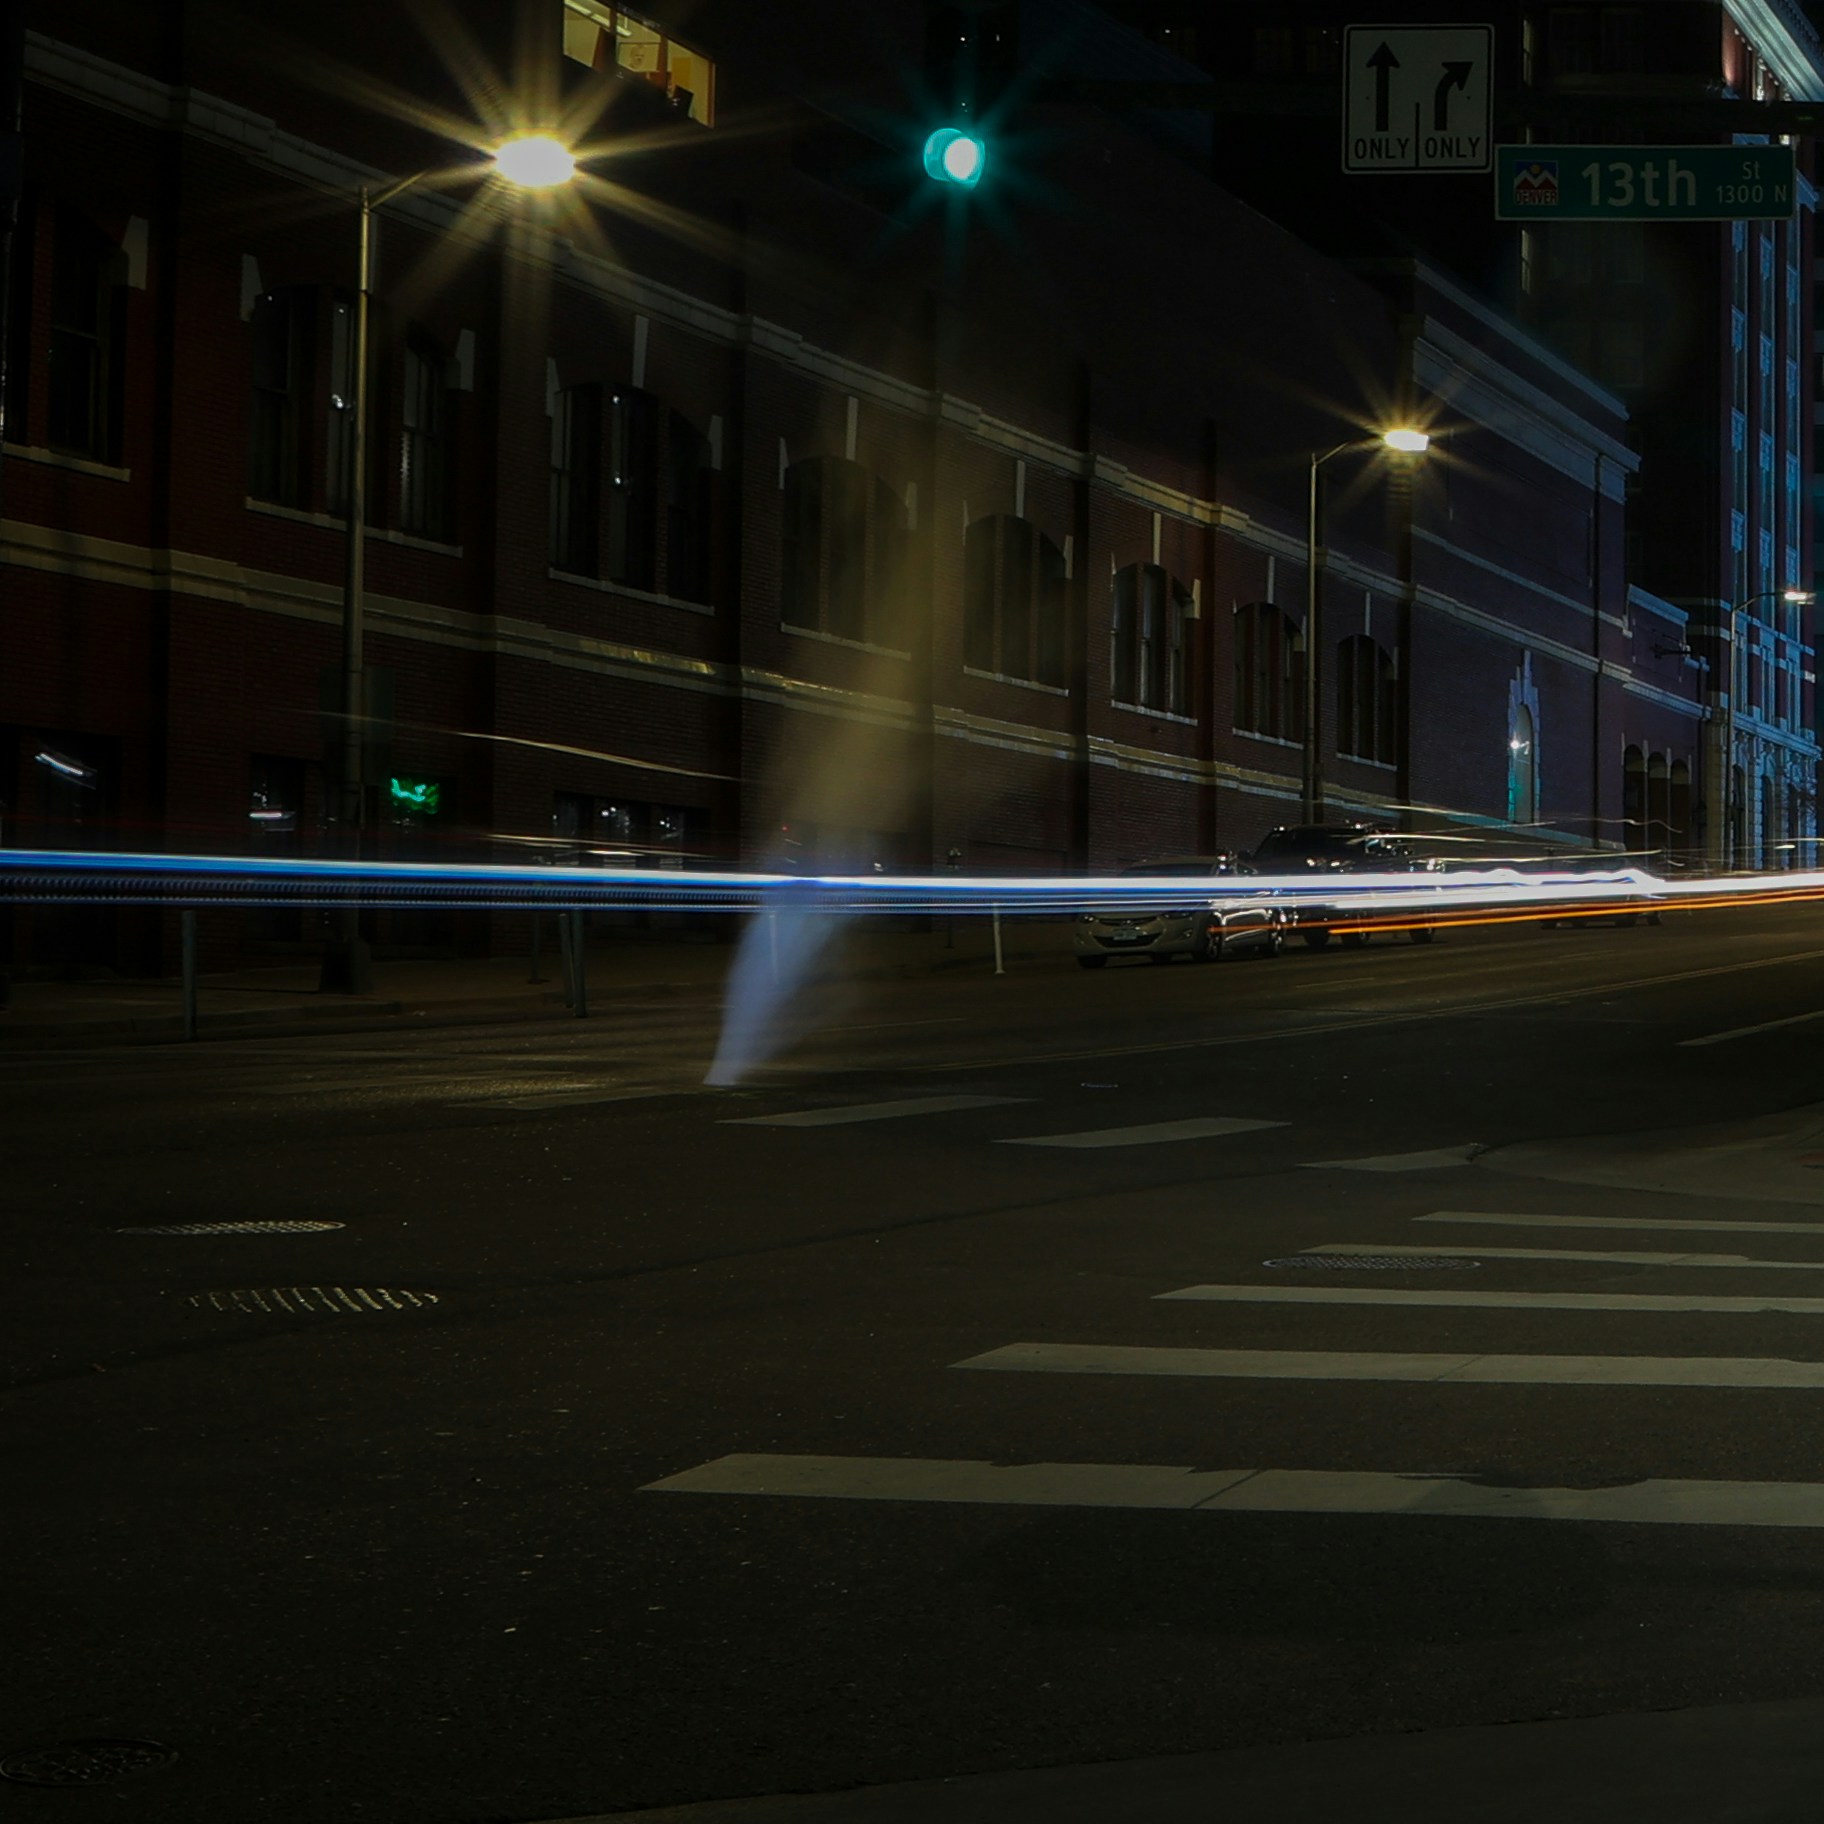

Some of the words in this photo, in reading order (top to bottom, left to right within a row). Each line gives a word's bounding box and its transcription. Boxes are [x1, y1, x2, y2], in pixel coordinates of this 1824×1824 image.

[1354, 137, 1410, 160] ONLY
[1424, 136, 1481, 159] ONLY
[1742, 160, 1761, 180] St
[1581, 159, 1697, 208] 13th
[1716, 184, 1764, 204] 1300
[1774, 184, 1788, 203] N
[1515, 188, 1557, 205] DENVER
